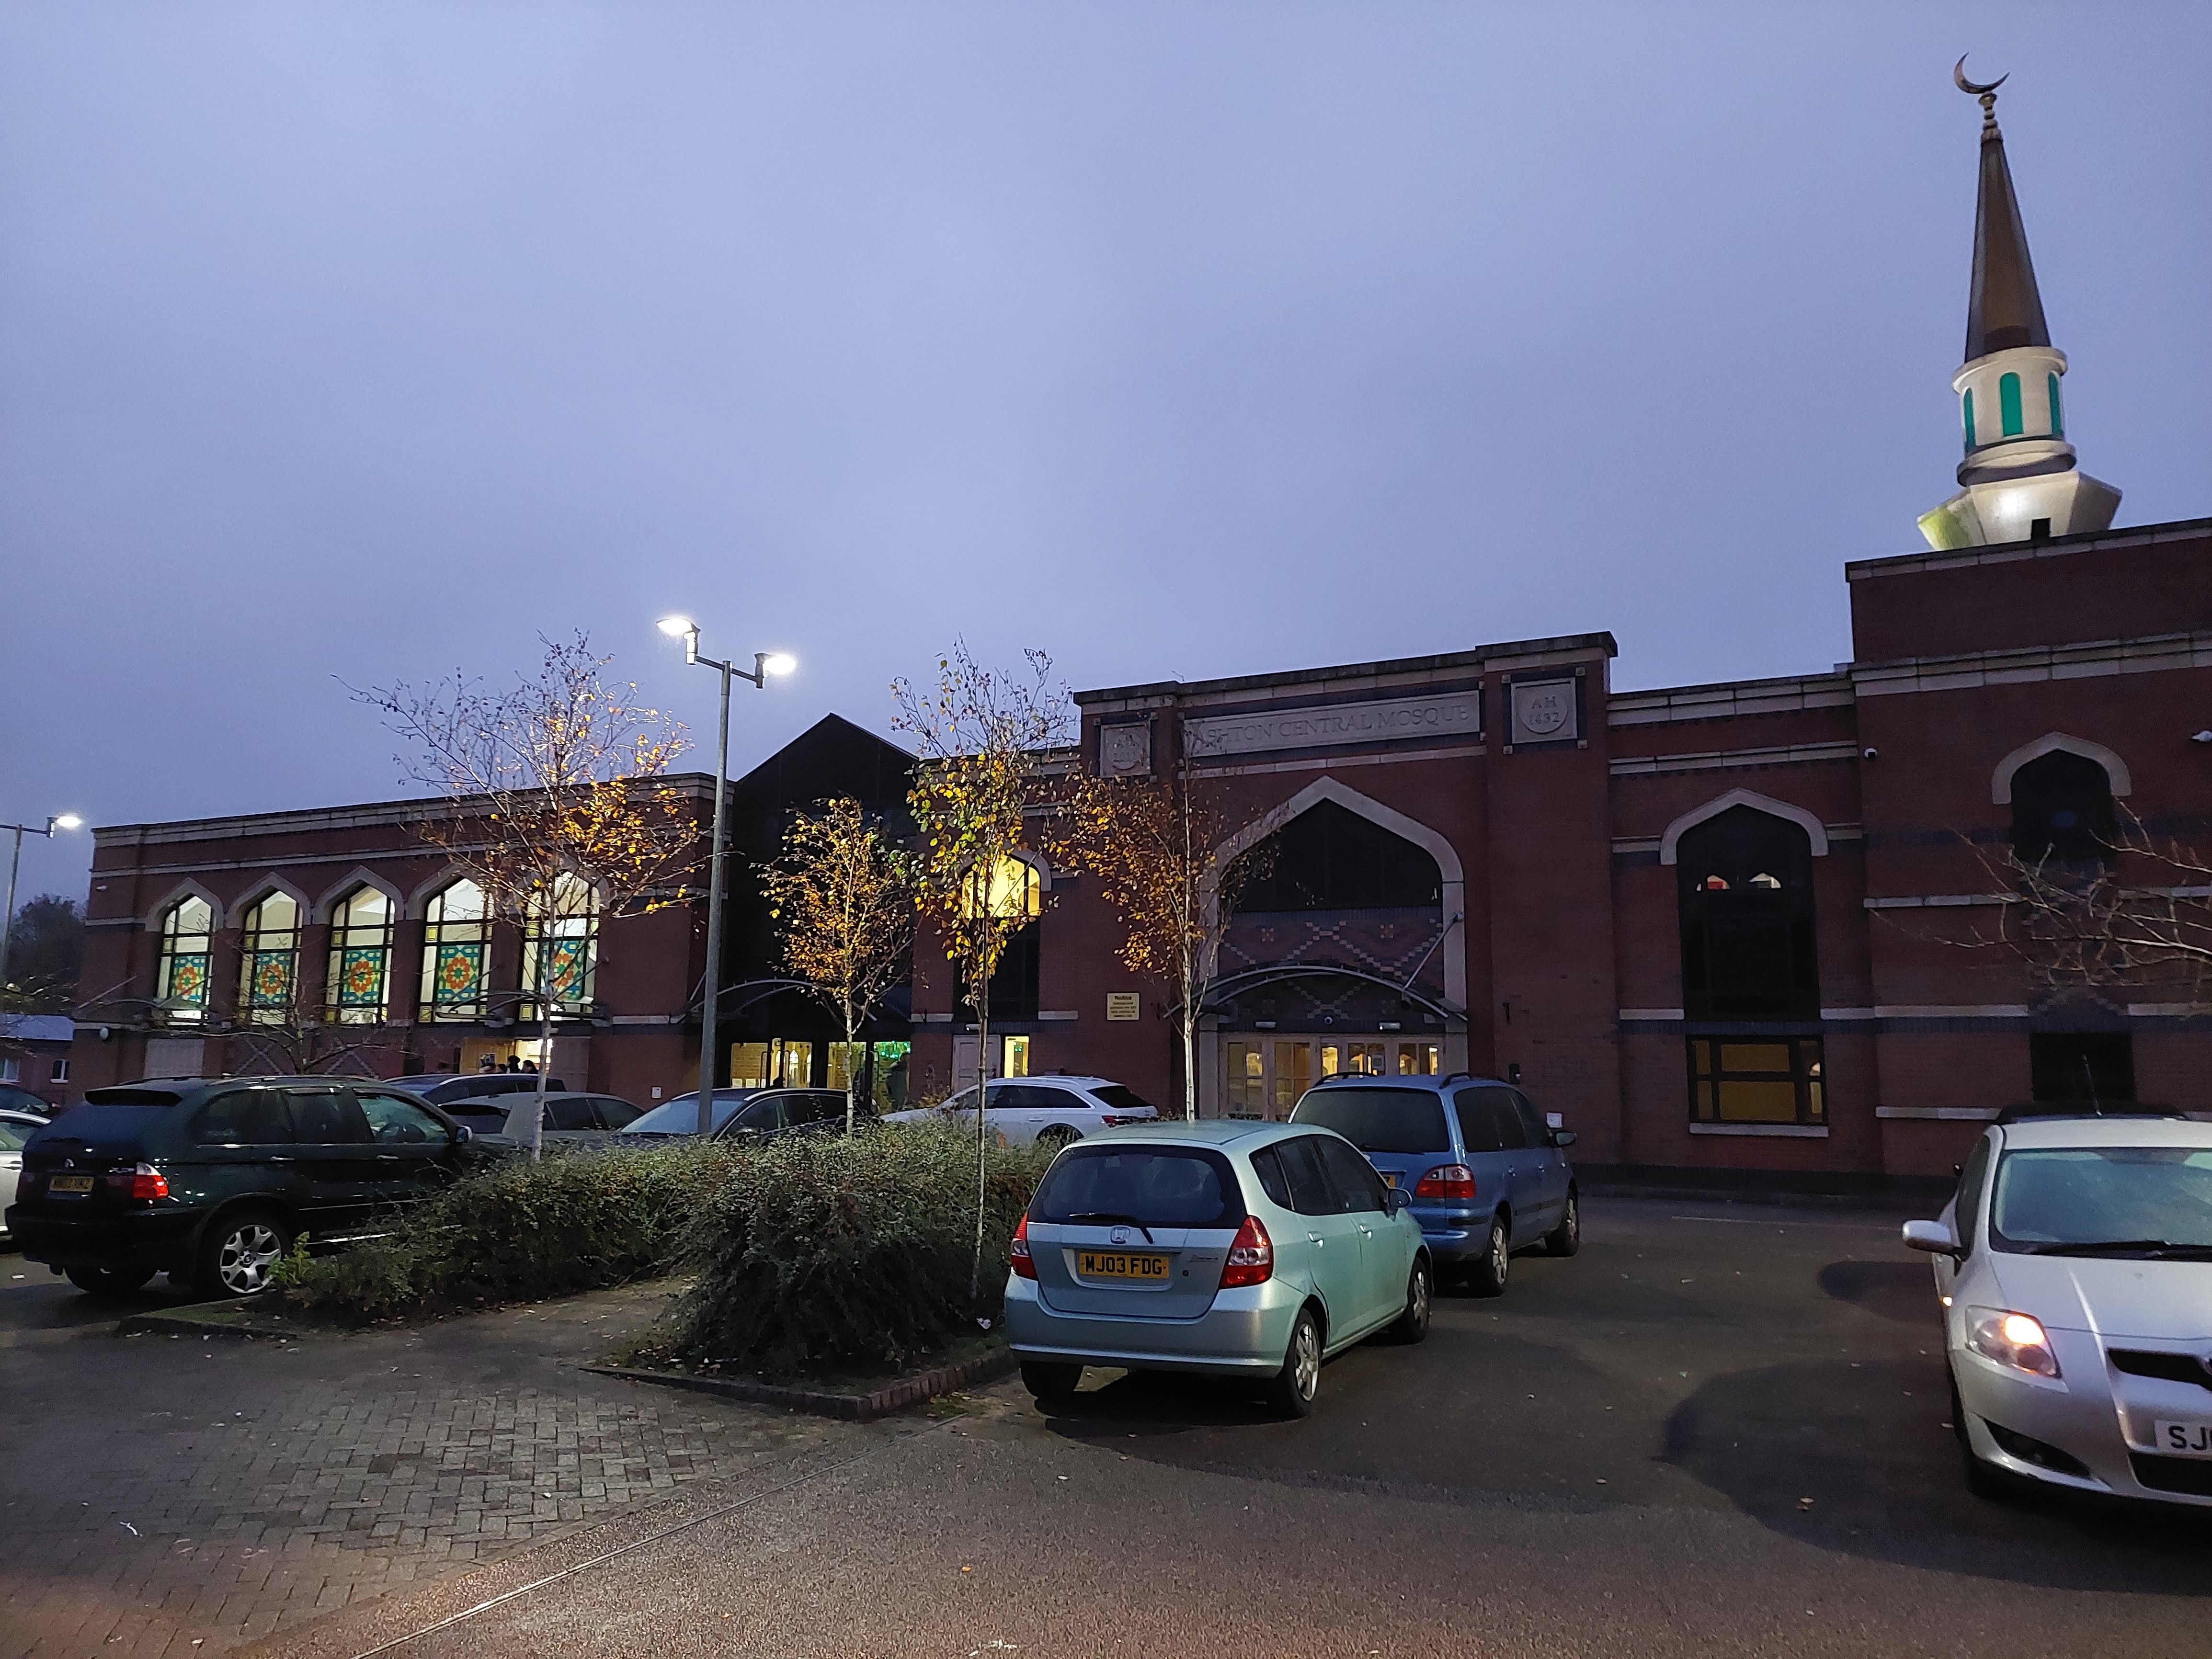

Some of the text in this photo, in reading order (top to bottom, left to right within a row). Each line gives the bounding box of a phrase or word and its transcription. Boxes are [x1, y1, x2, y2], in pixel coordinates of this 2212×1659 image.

[1279, 714, 1372, 737] CENTRAL
[1377, 705, 1468, 728] MOSQUE
[1085, 1255, 1162, 1275] MJ03 FDG
